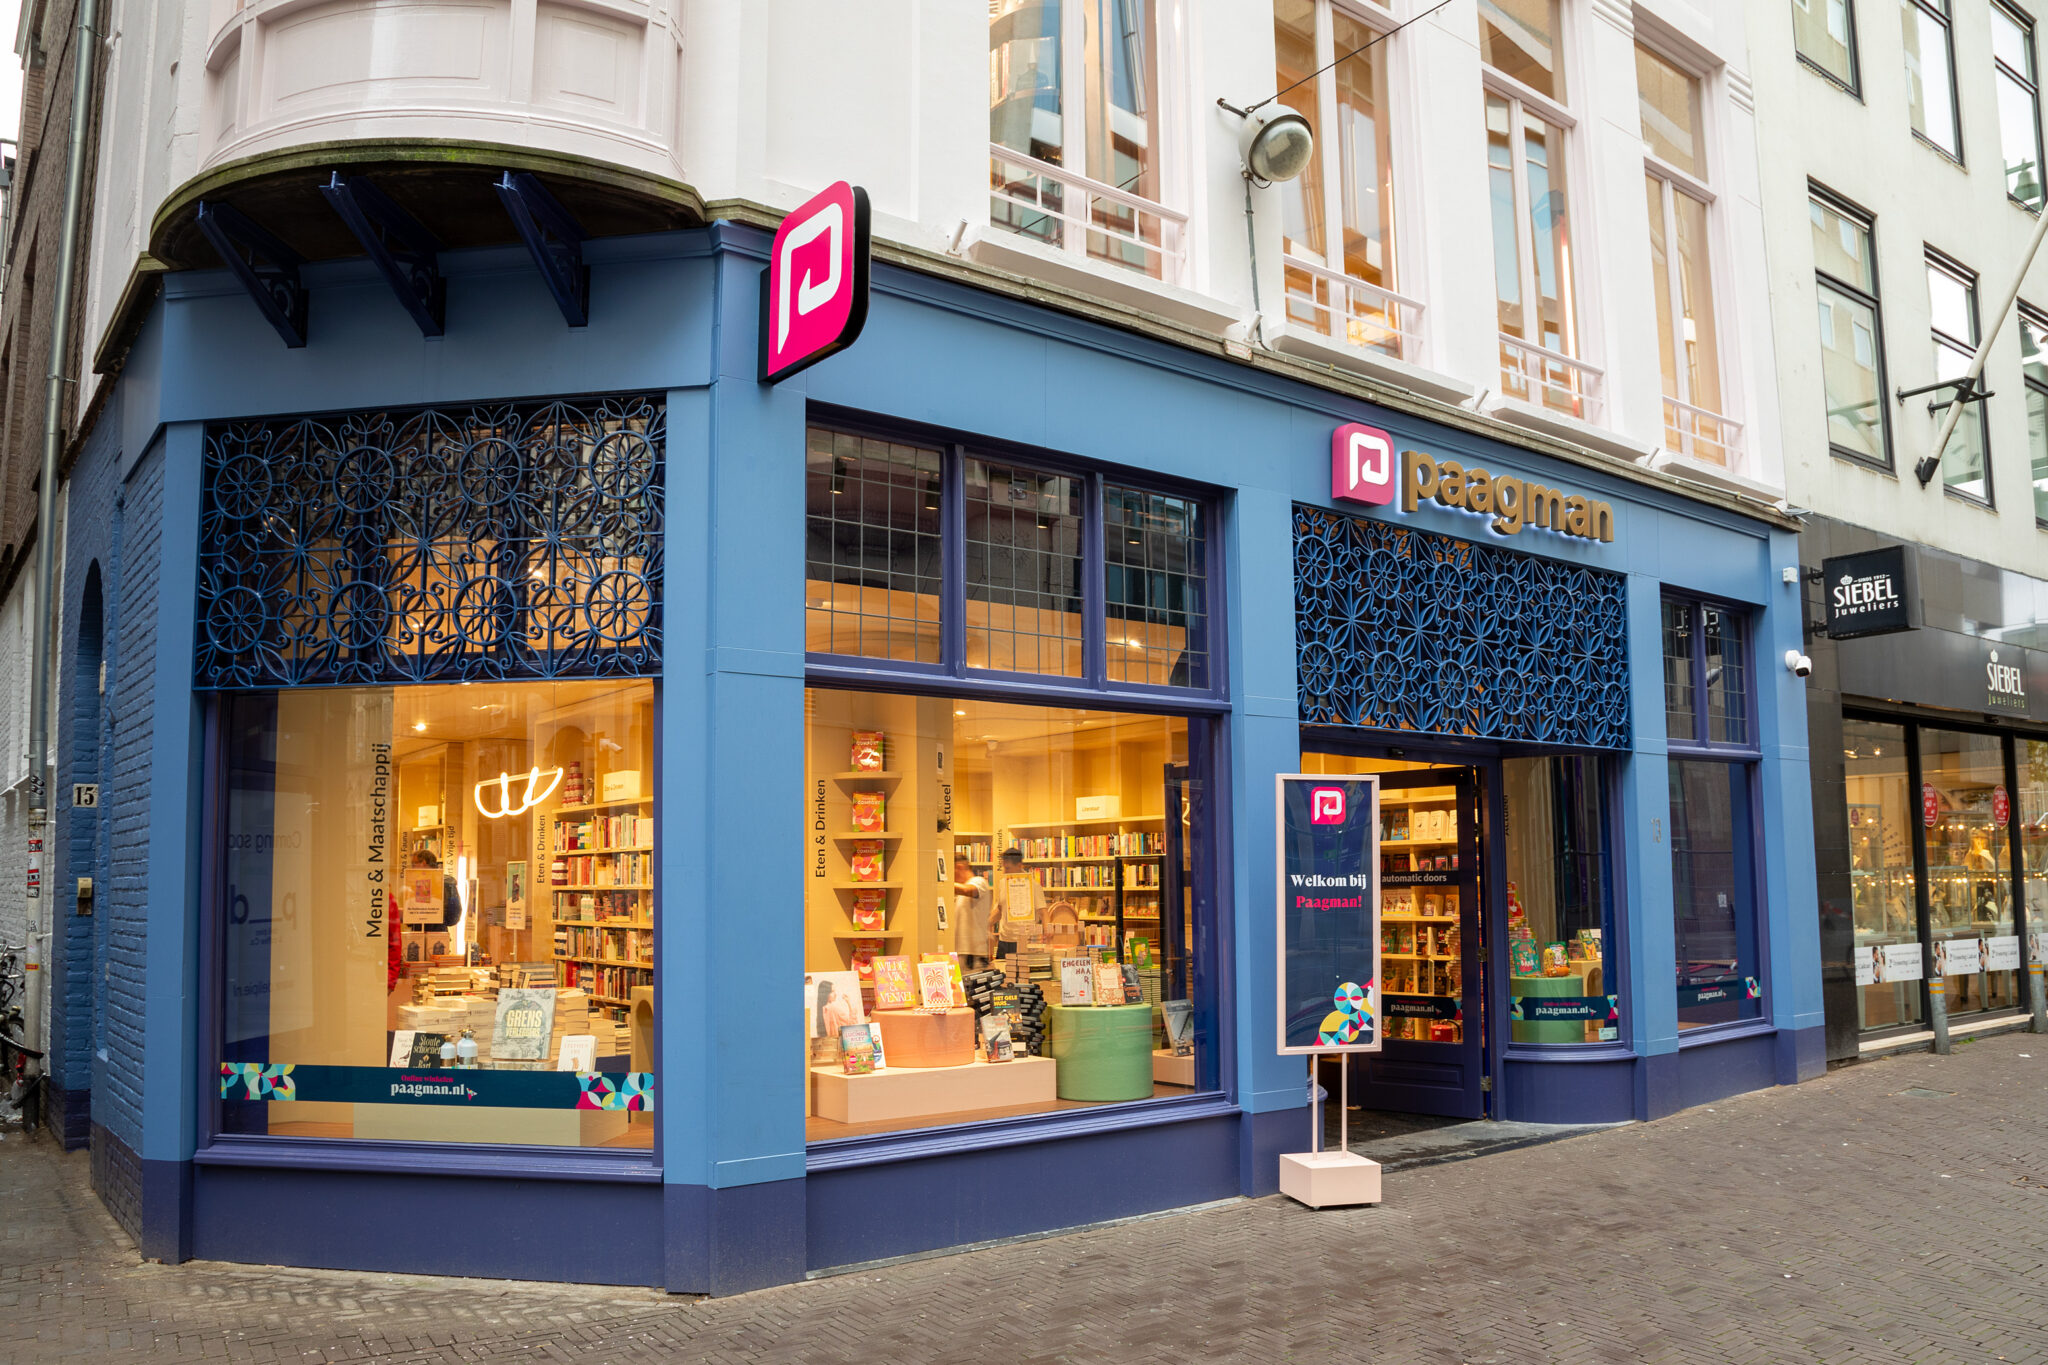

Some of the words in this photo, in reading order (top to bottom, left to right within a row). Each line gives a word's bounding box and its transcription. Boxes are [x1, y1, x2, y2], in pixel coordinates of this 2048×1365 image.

[1401, 450, 1614, 542] paagman
[1833, 578, 1899, 608] SIEBEL
[1987, 662, 2025, 696] SIEBEL
[76, 786, 95, 806] 15
[368, 743, 391, 862] Maatschappij
[815, 779, 826, 831] Drinken
[537, 815, 546, 851] Drinken
[815, 835, 826, 845] &
[537, 862, 545, 884] Eten
[815, 849, 826, 878] Eten
[368, 868, 383, 883] &
[1291, 874, 1347, 888] Welkom
[1349, 874, 1367, 890] bij
[1381, 873, 1422, 883] automatic
[1423, 873, 1447, 882] doors
[366, 888, 383, 938] Mens
[1296, 895, 1362, 911] Paagman!
[1390, 1004, 1435, 1013] paagman.nl
[1535, 1006, 1589, 1016] paagman.nl
[506, 1010, 543, 1028] GRENS
[391, 1083, 465, 1097] paagman.nl
